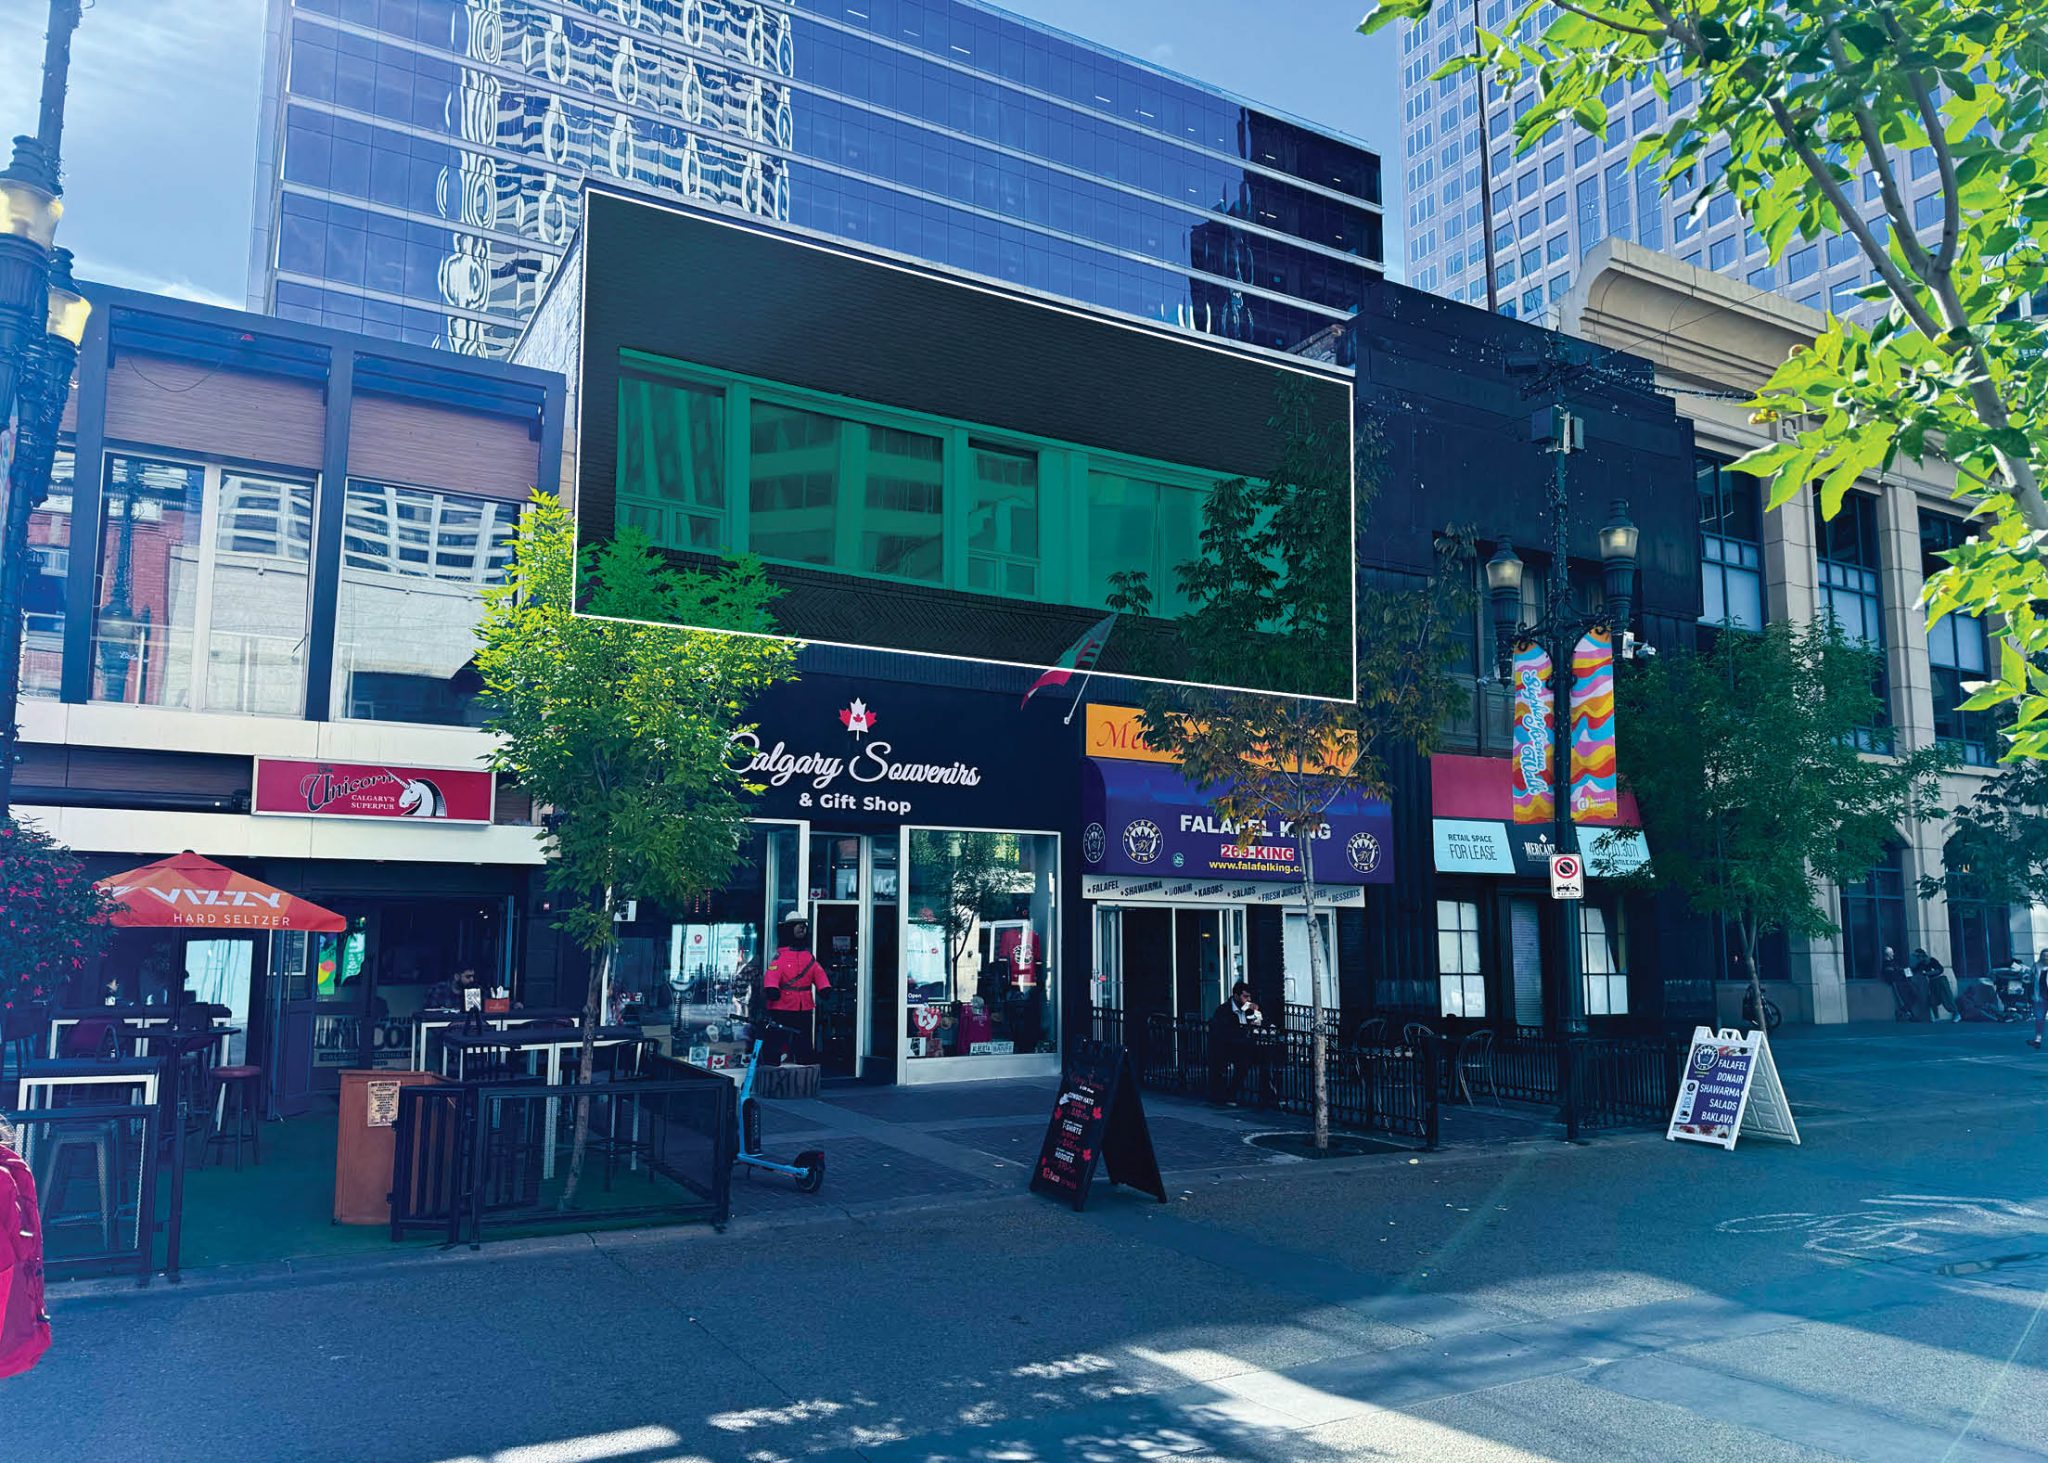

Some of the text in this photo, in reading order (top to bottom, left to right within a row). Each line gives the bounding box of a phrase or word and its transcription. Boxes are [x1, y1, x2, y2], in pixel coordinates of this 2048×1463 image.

[1522, 671, 1550, 727] Stephen
[1522, 715, 1548, 770] Avenue
[728, 732, 981, 789] Calgary Souvenirs
[1520, 746, 1549, 796] Walk
[300, 773, 397, 813] Unicorn
[351, 794, 395, 803] CALGARY'S
[351, 802, 395, 810] SUPERPUB
[799, 792, 912, 815] & Gift Shop
[1448, 834, 1493, 843] RETAIL SPACE
[1449, 844, 1497, 861] FOR LEASE
[1208, 860, 1302, 874] www.falafelking.c
[1092, 880, 1120, 894] FALAFEL
[1124, 880, 1163, 897] SHAWARMA
[1198, 884, 1223, 897] KABOBS
[1232, 886, 1256, 898] SALADS
[1261, 891, 1281, 902] FRESH
[1281, 885, 1302, 898] JUICES
[1331, 889, 1361, 903] DESSERTS
[173, 913, 290, 927] HARD SELTZER
[1718, 1059, 1747, 1071] FALAFEL
[1717, 1073, 1744, 1084] DONAIR
[1700, 1084, 1740, 1097] SHAWARMA
[1709, 1098, 1738, 1110] SALADS
[1701, 1111, 1734, 1125] BAKLAVA
